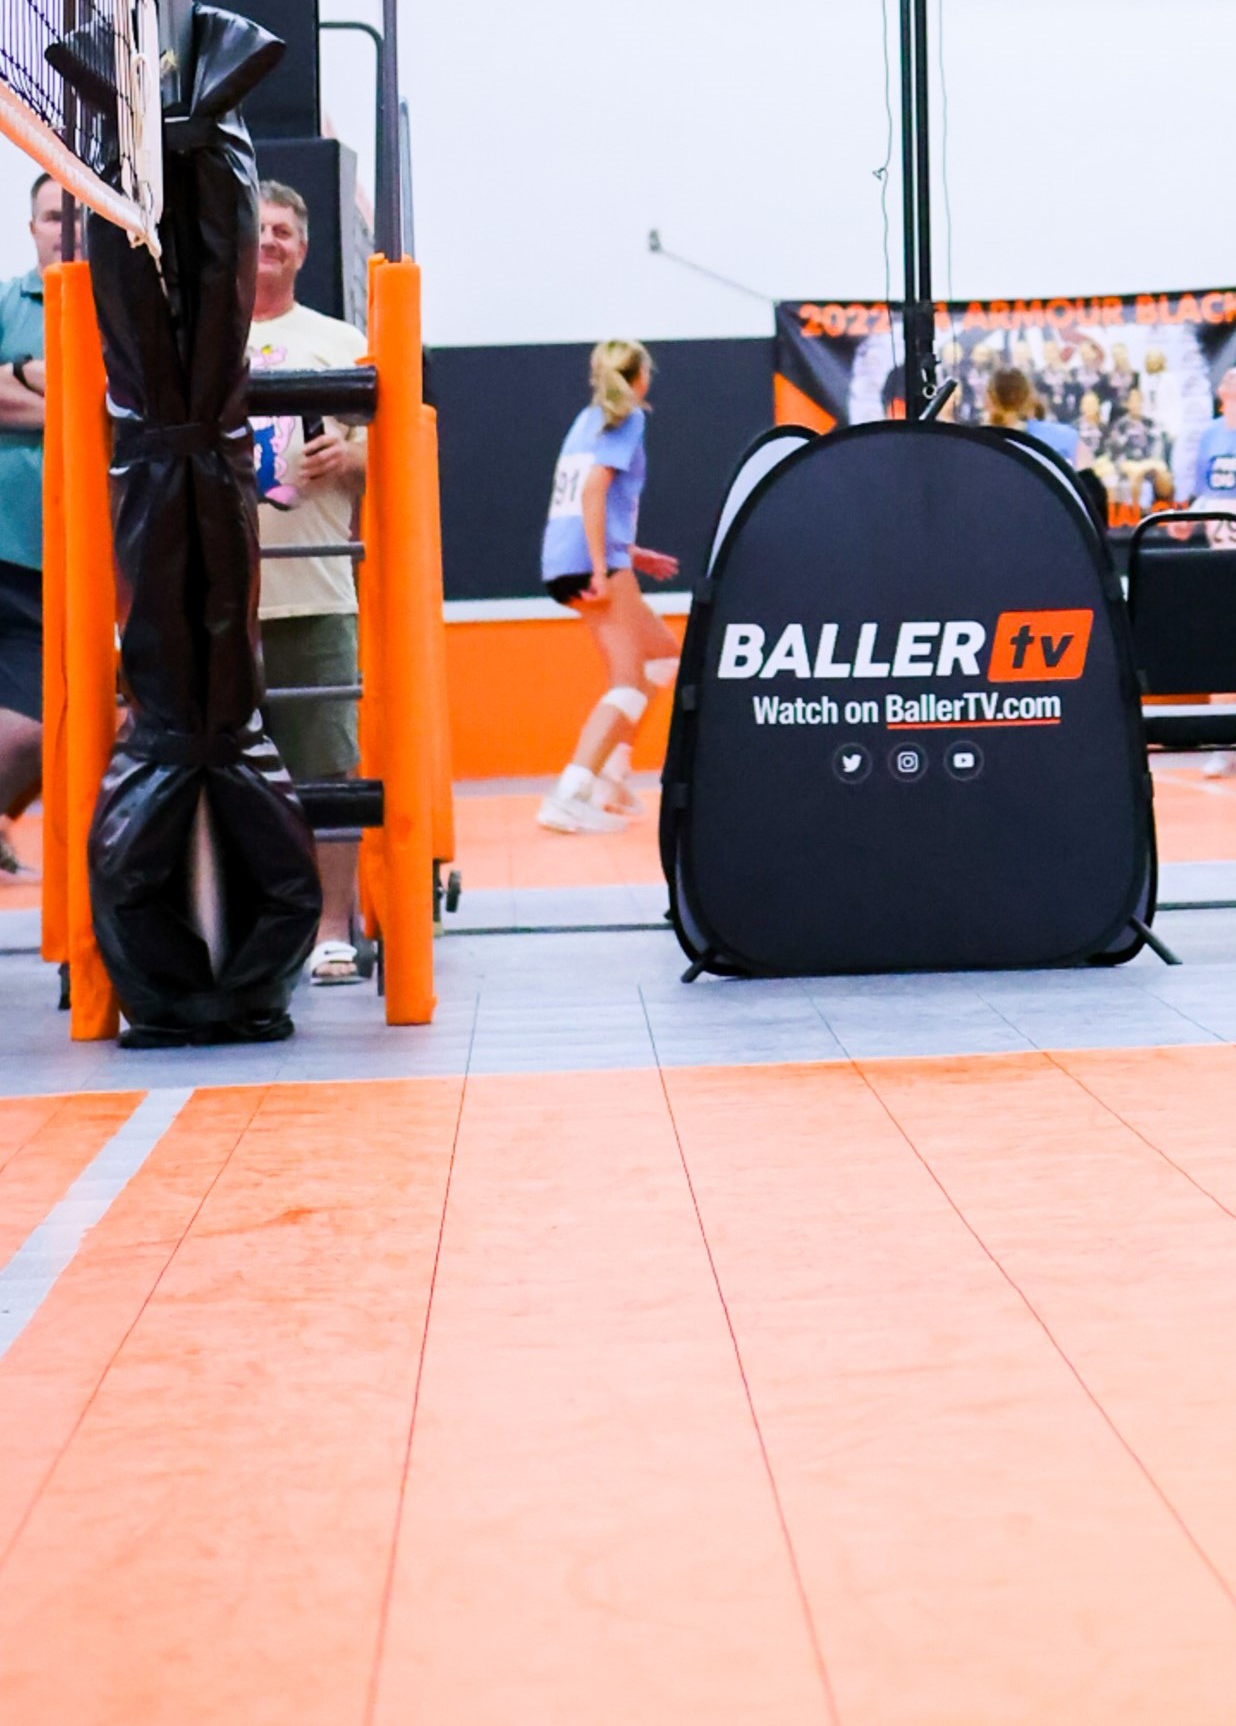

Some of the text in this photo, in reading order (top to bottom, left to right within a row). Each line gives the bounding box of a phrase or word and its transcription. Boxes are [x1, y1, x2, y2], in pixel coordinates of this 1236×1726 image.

[800, 301, 891, 338] 2022
[963, 295, 1124, 332] ARMOUR
[717, 621, 1073, 679] BALLER tv
[754, 692, 1061, 724] Watch on BallerTV.com
